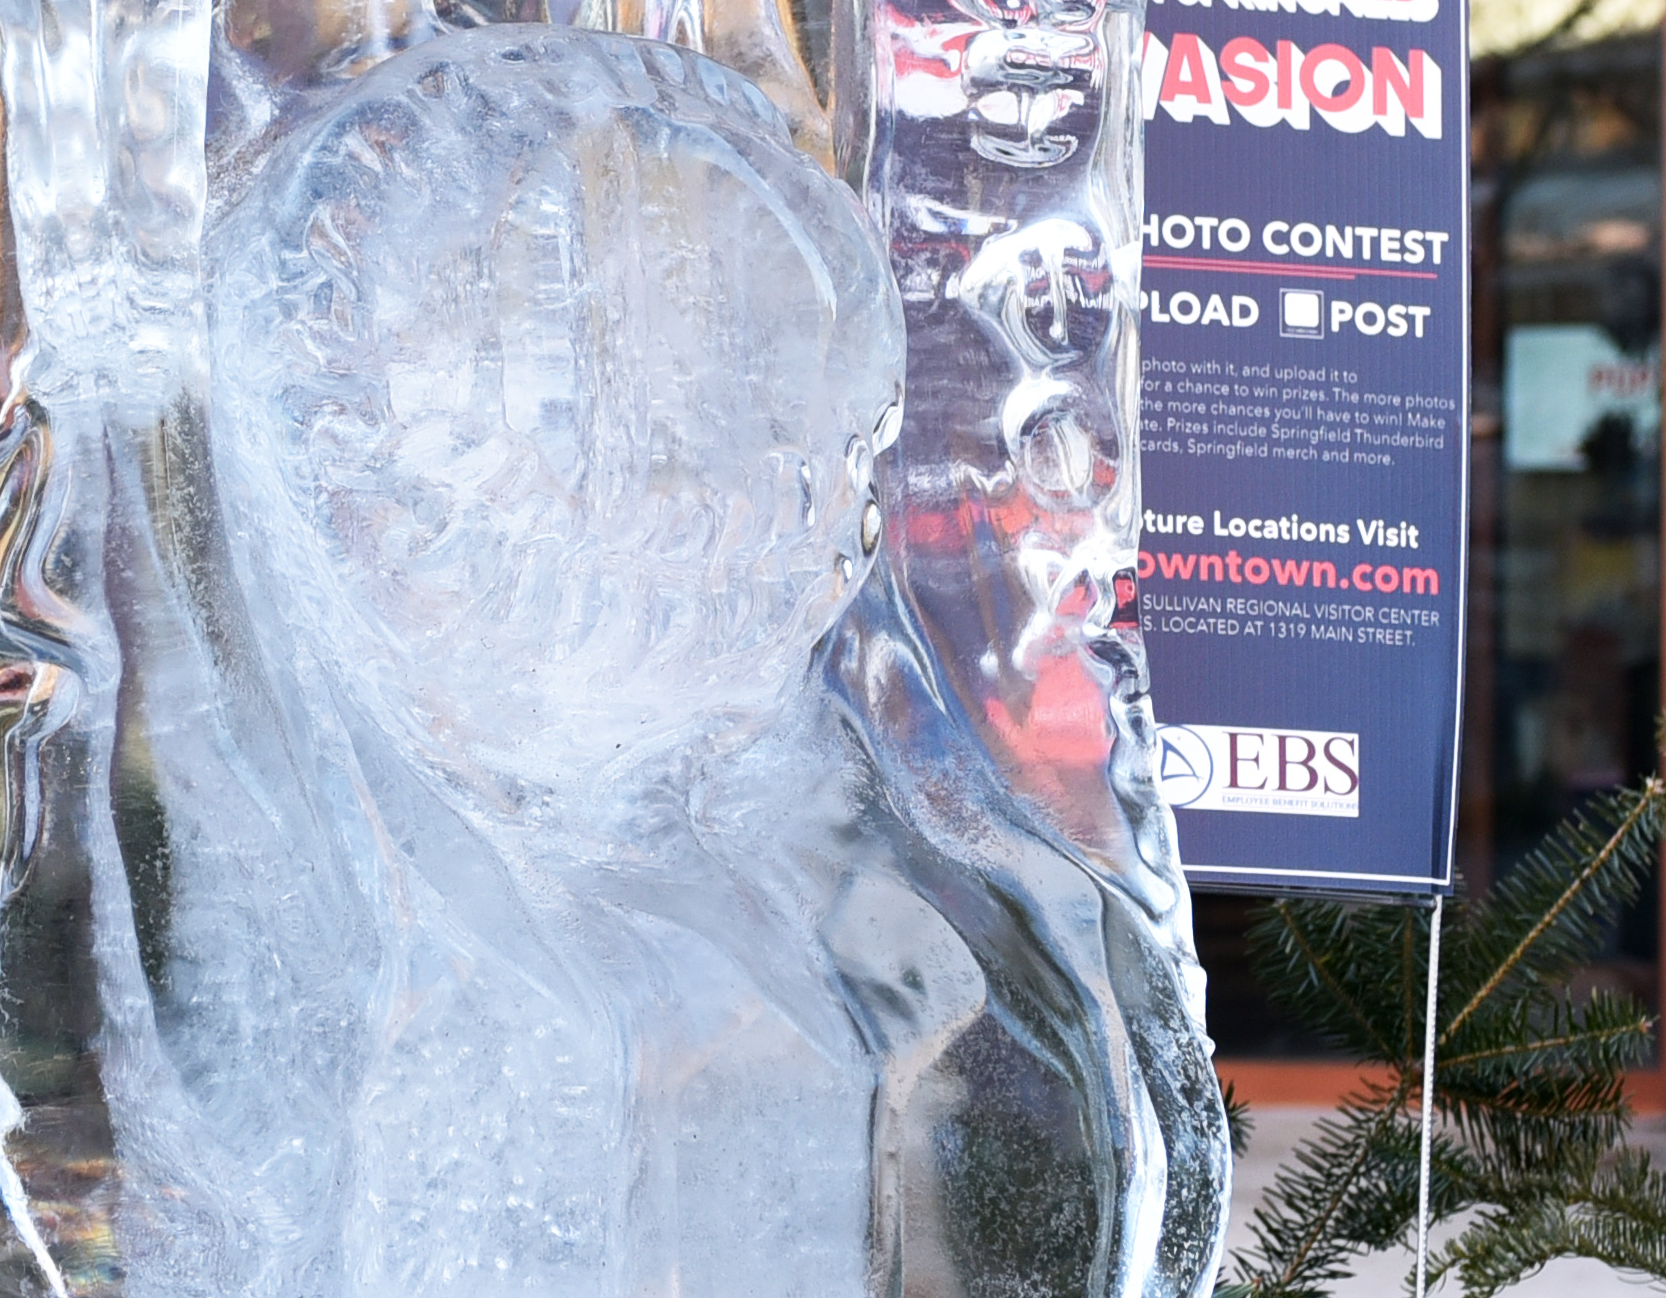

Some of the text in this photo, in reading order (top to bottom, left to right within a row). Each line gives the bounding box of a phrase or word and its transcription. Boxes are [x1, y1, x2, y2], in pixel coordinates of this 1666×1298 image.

[1142, 31, 1424, 119] ASION
[1261, 220, 1449, 265] CONTEST
[1331, 300, 1431, 339] POST
[1141, 357, 1186, 373] photo
[1190, 359, 1221, 375] with
[1242, 363, 1270, 378] and
[1274, 365, 1326, 382] upload
[1330, 368, 1339, 382] it
[1343, 370, 1358, 383] to
[1164, 381, 1173, 393] a
[1177, 378, 1230, 396] chance
[1234, 383, 1249, 397] to
[1253, 385, 1278, 399] win
[1282, 386, 1330, 402] prizes.
[1332, 387, 1360, 404] The
[1363, 392, 1401, 406] more
[1405, 392, 1456, 411] photos
[1167, 401, 1207, 414] more
[1210, 399, 1271, 418] chances
[1274, 405, 1313, 423] you'll
[1317, 406, 1351, 424] have
[1354, 410, 1370, 425] to
[1373, 412, 1403, 426] win!
[1407, 412, 1446, 430] Make
[1167, 417, 1209, 434] Prizes
[1213, 420, 1267, 438] include
[1271, 423, 1351, 445] Springfield
[1354, 428, 1444, 450] Thunderbird
[1140, 437, 1395, 466] cards, Springfield merch and more.
[1213, 510, 1351, 544] Locations
[1356, 518, 1420, 549] Visit
[1143, 593, 1440, 626] SULLIVAN REGIONAL VISITOR CENTER
[1161, 617, 1240, 636] LOCATED
[1243, 621, 1264, 638] AT
[1269, 622, 1306, 639] 1319
[1311, 624, 1354, 642] MAIN
[1357, 627, 1416, 647] STREET.
[1221, 731, 1359, 796] EBS
